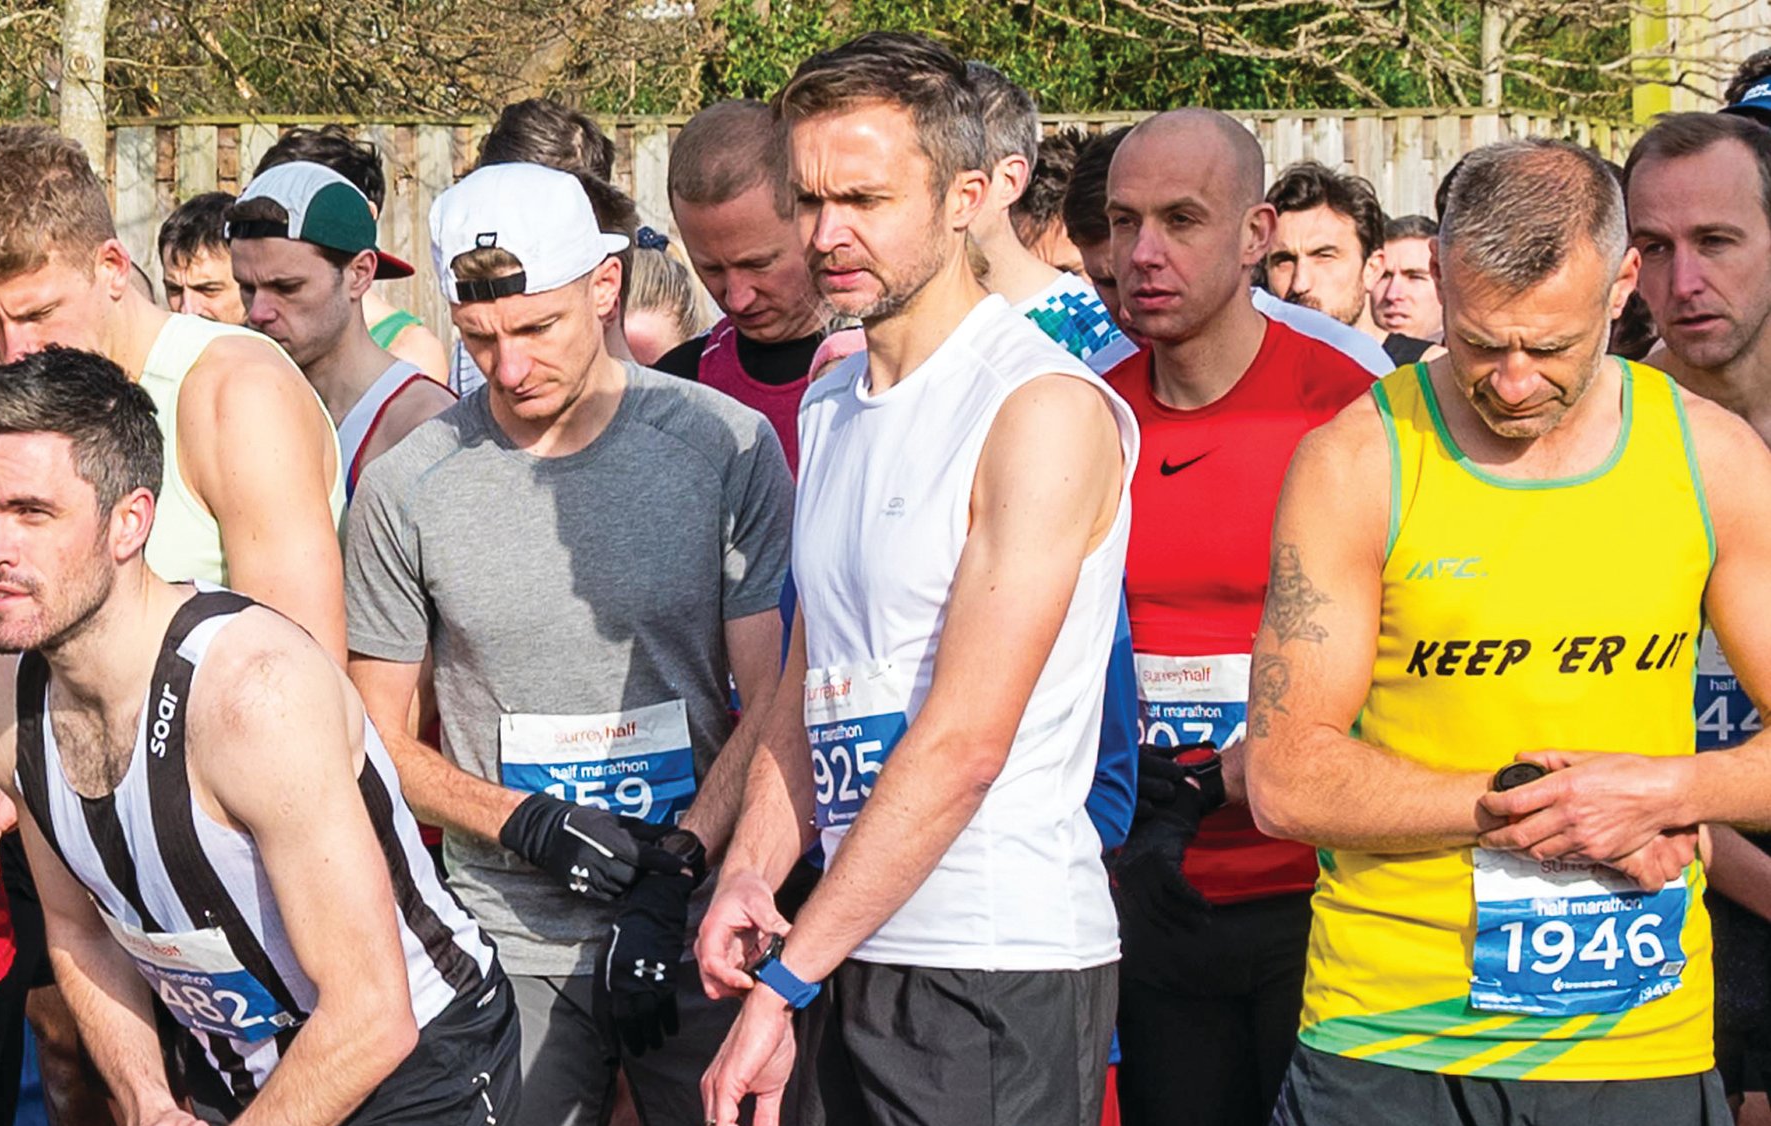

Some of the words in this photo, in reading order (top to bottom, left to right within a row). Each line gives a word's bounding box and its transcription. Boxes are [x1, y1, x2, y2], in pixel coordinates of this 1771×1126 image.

[1406, 639, 1532, 678] KEEP
[1710, 678, 1737, 691] half
[150, 682, 179, 759] soar
[1163, 704, 1222, 719] marathon
[549, 765, 578, 779] half
[581, 760, 649, 778] marathon
[1534, 897, 1569, 917] half
[1571, 896, 1644, 916] marathon
[1500, 913, 1666, 975] 1946
[159, 978, 266, 1029] 482
